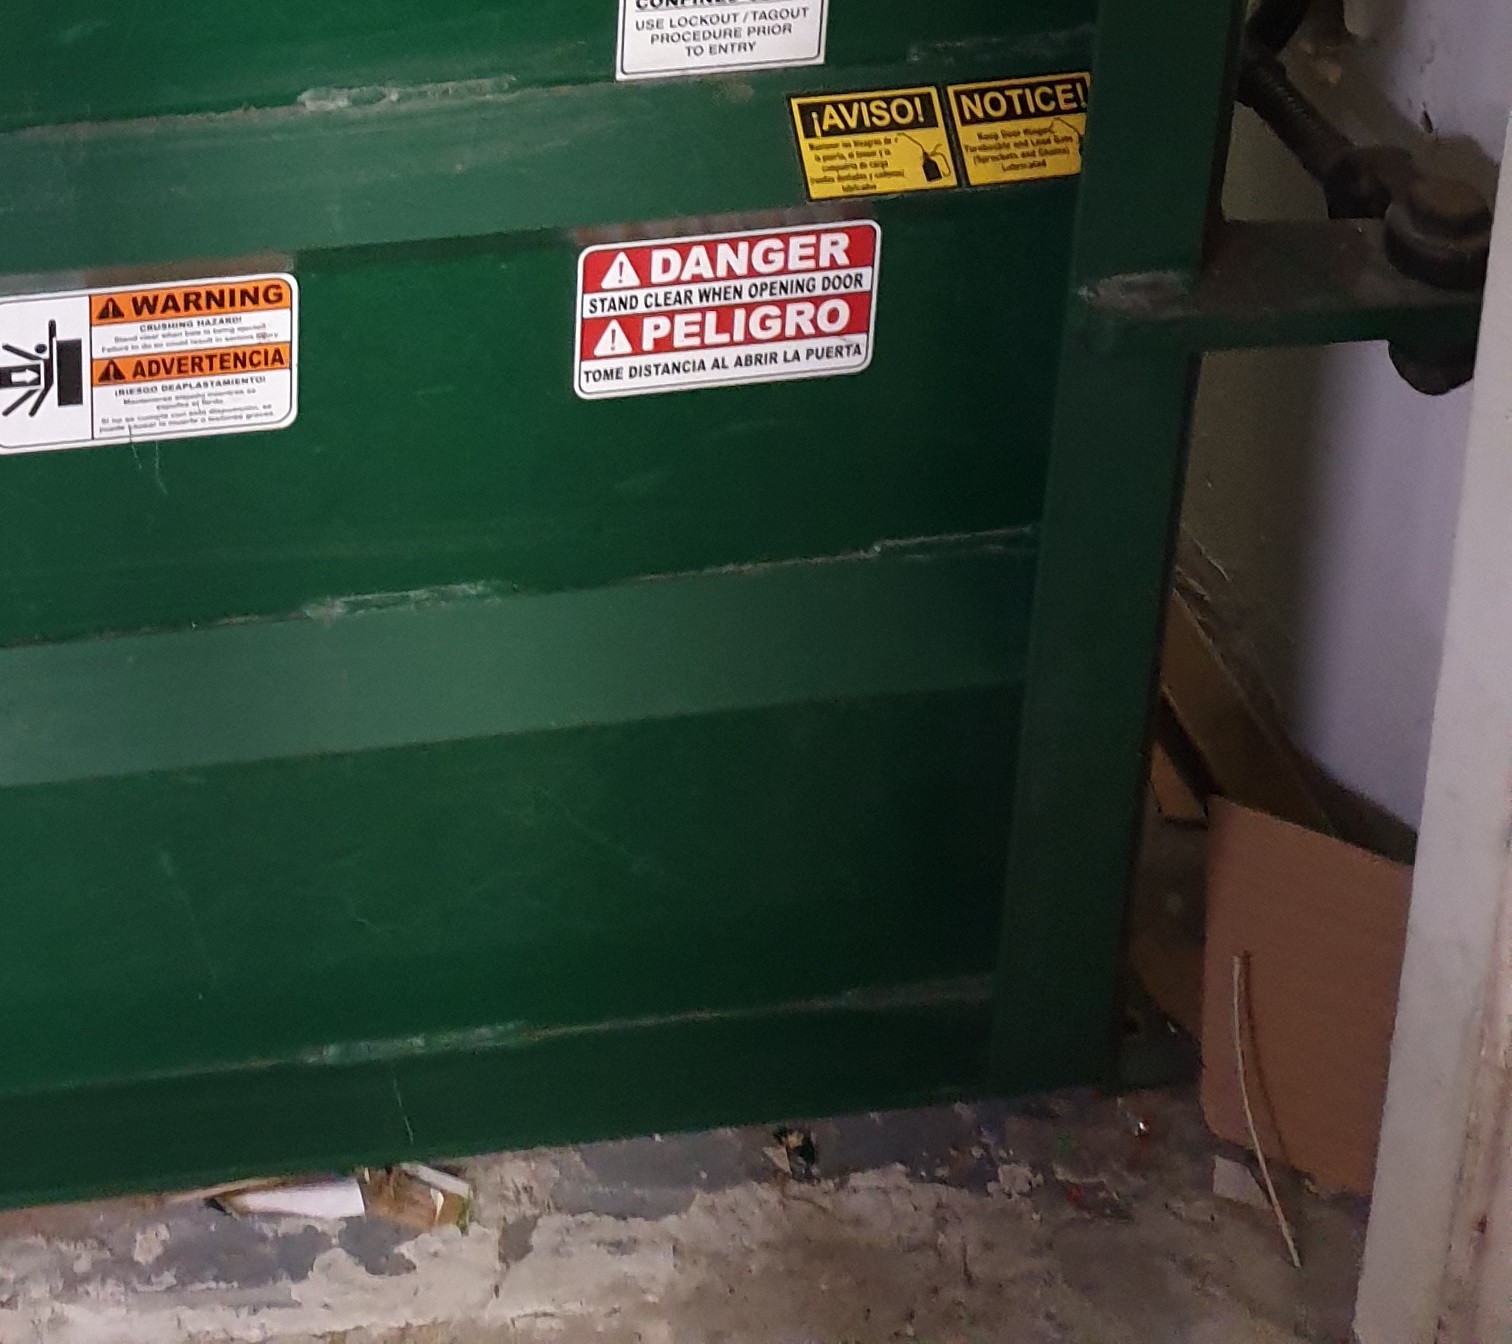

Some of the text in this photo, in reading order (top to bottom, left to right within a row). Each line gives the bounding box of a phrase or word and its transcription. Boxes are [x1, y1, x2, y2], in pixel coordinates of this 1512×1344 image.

[636, 17, 664, 31] USE
[651, 23, 792, 44] PROCEDURE PRIOR
[686, 42, 756, 57] TO ENTRY
[812, 96, 924, 138] ¡AVISO!
[960, 83, 1086, 120] NOTICE!
[651, 233, 850, 284] DANGER
[131, 283, 283, 317] WARNING
[589, 273, 863, 314] STAND CLEAR WHEN OPENING DOOR
[140, 321, 193, 332] CRUSHING
[642, 299, 850, 352] PELIGRO
[132, 347, 285, 379] ADVERTENCIA
[584, 344, 861, 383] TOME DISTANCIA AL ABRIR LA PUERTA
